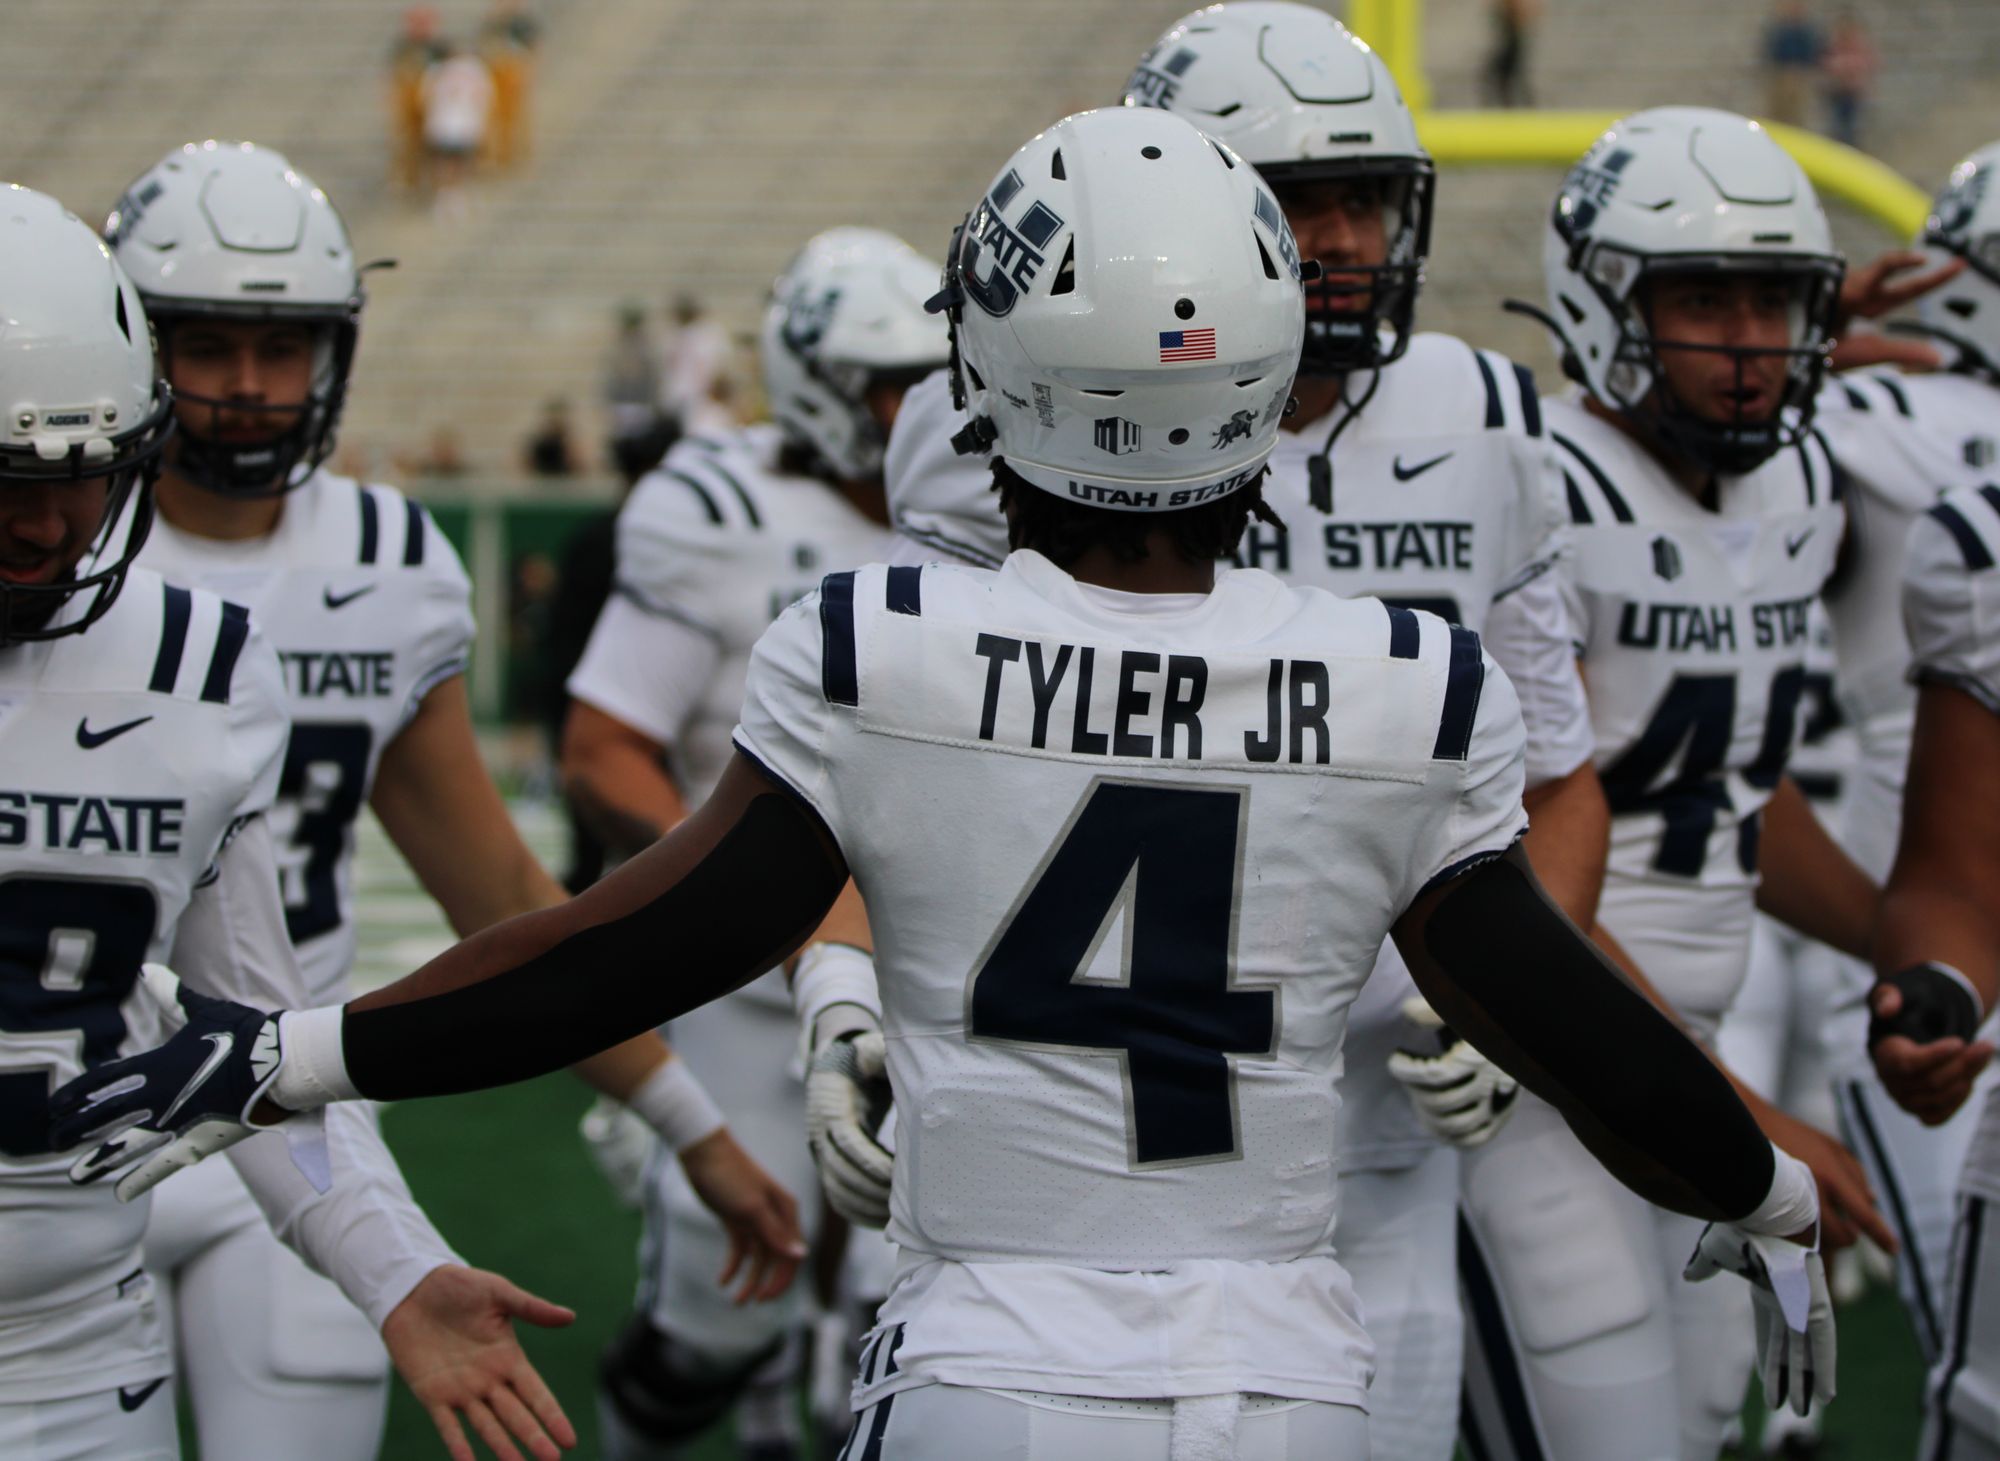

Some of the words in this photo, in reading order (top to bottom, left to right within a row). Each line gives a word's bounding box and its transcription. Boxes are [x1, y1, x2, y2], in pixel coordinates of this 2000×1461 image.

[969, 195, 1045, 295] STATE
[1069, 480, 1158, 507] UTAH
[1168, 466, 1255, 507] STATE
[1323, 522, 1474, 570] STATE
[1617, 602, 1736, 650] UTAH
[277, 650, 394, 697] TATE
[975, 632, 1209, 760] TYLER
[1243, 658, 1330, 764] JR
[0, 792, 186, 856] STATE
[964, 774, 1282, 1172] 4
